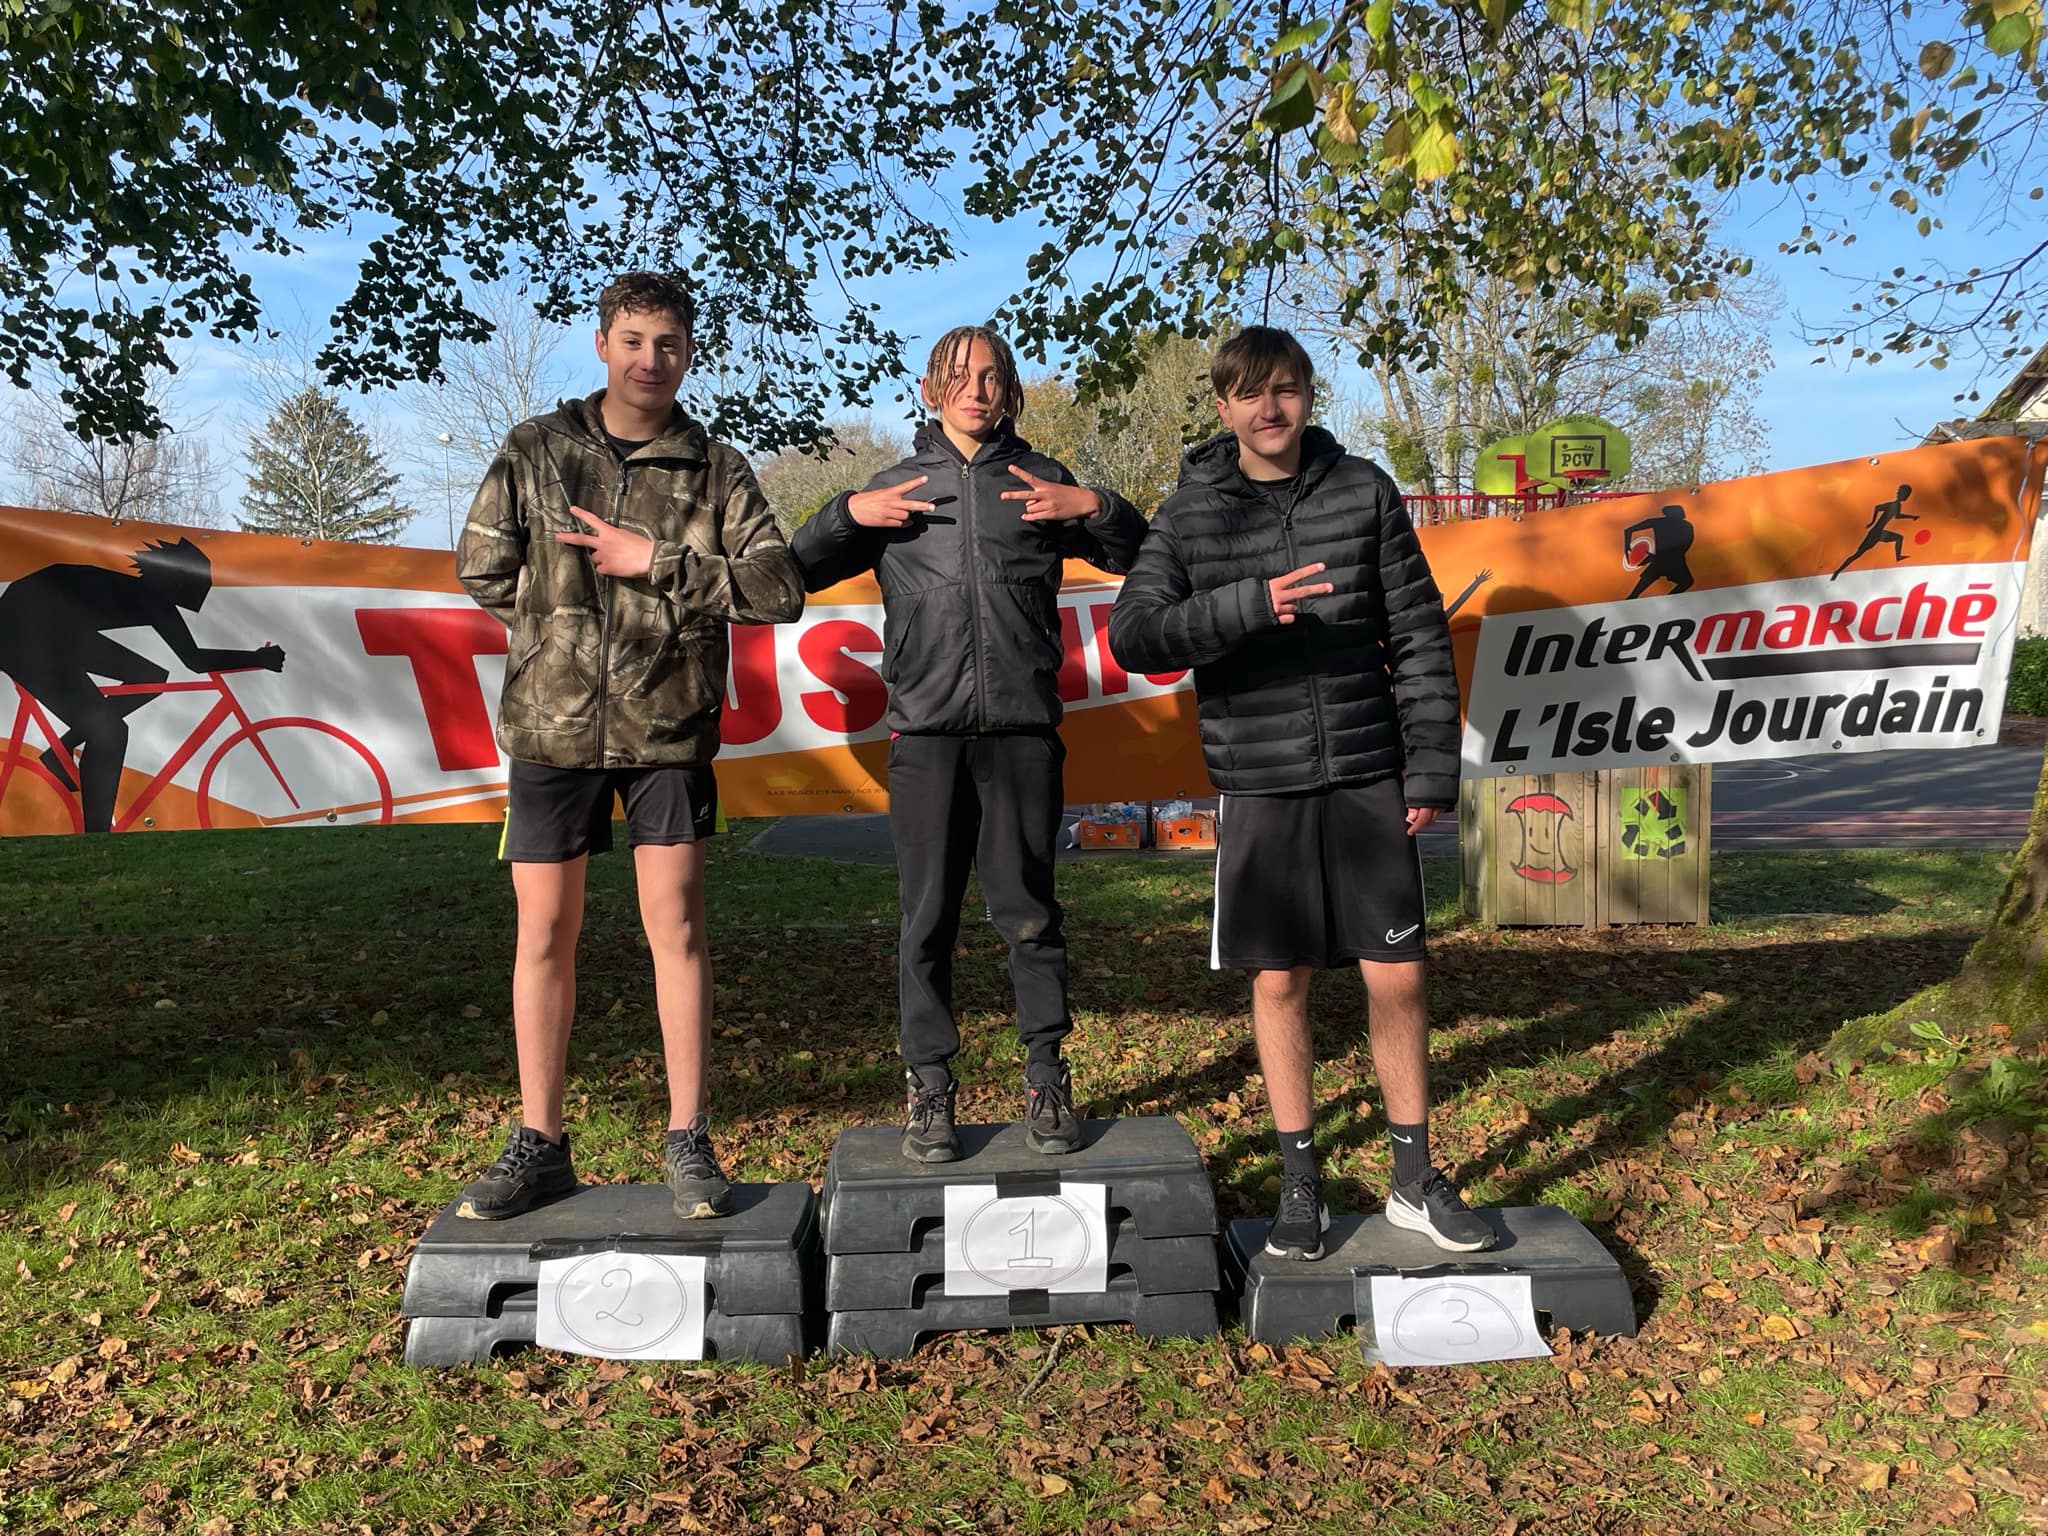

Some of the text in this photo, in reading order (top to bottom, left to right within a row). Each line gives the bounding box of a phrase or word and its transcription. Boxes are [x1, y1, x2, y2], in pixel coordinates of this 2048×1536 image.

[1561, 452, 1594, 467] PCV
[355, 608, 888, 772] TUS
[1490, 675, 1983, 763] L'Isle Jourdain
[1008, 1207, 1053, 1268] 1
[595, 1268, 643, 1326] 2
[1441, 1299, 1480, 1345] 3
